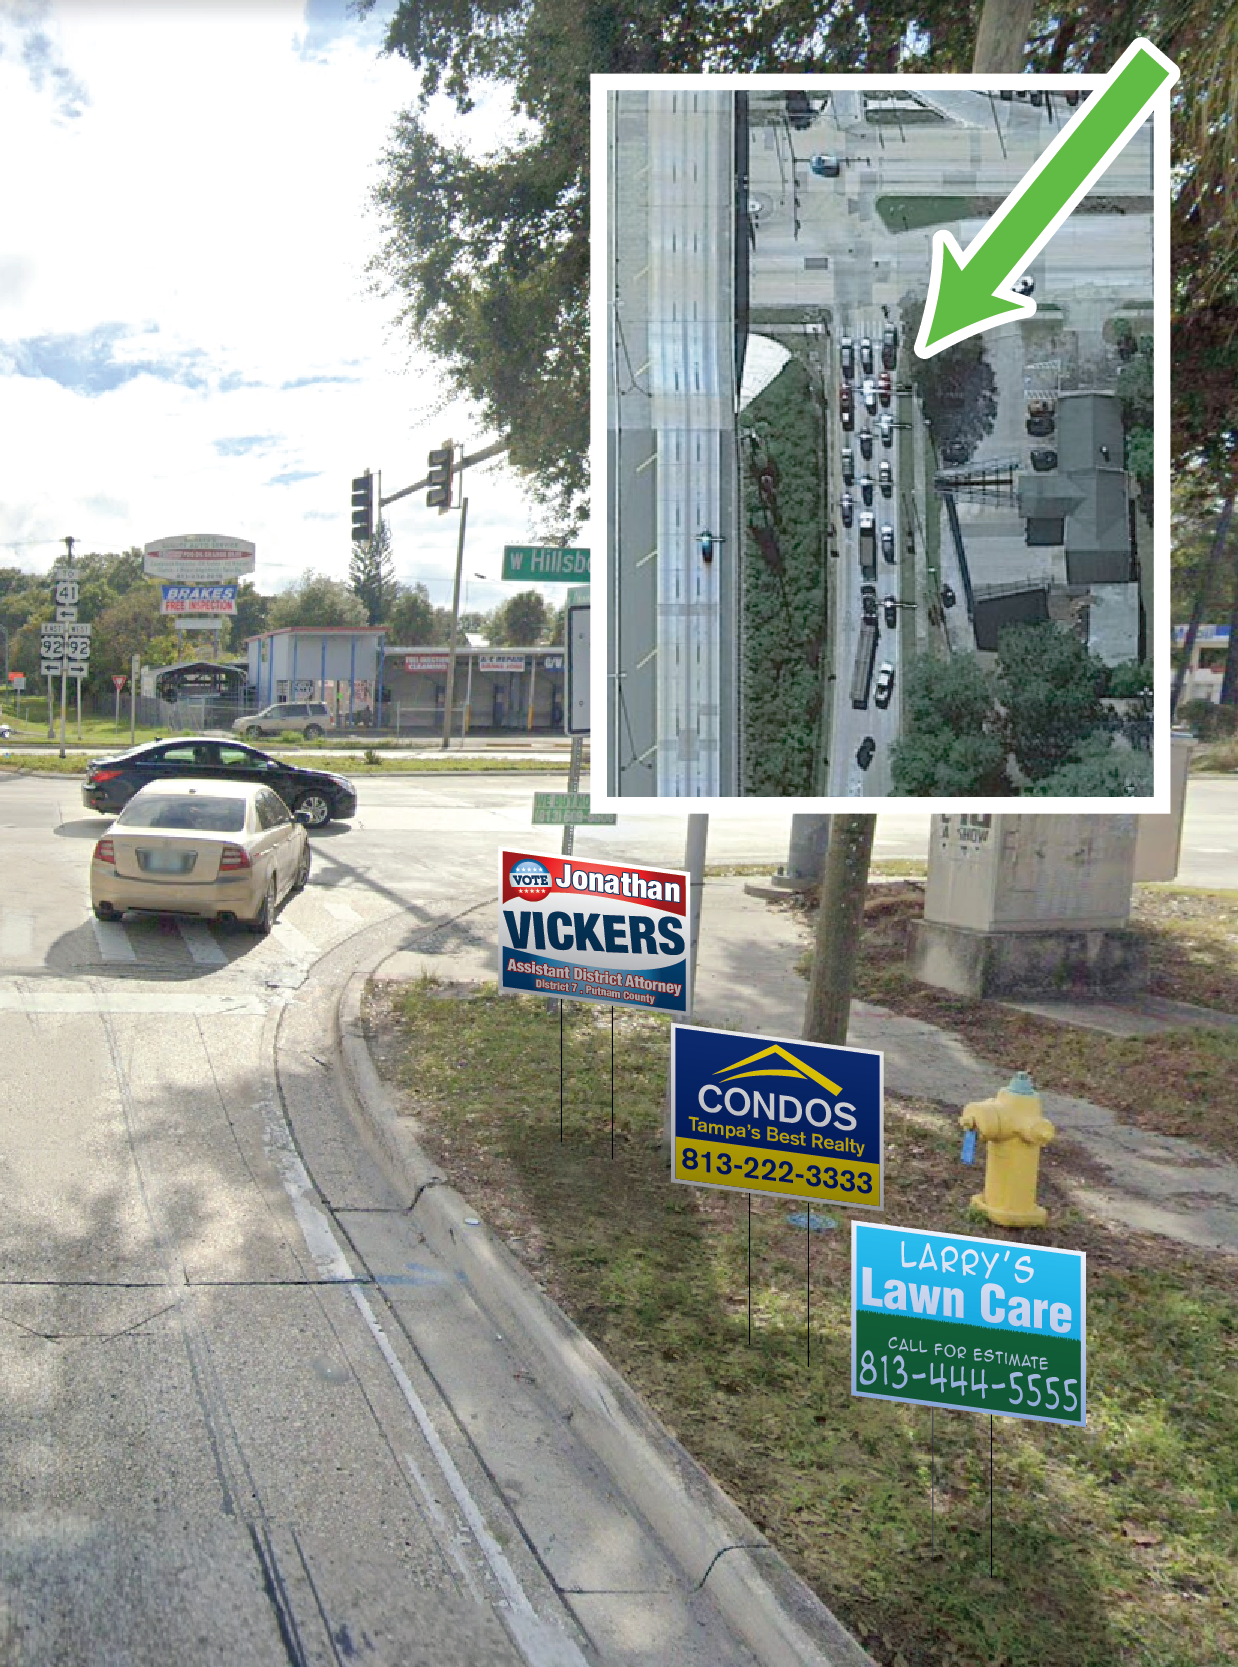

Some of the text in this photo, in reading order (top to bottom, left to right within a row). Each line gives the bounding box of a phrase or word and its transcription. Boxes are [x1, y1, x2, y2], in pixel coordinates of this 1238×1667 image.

[62, 569, 74, 578] TO
[510, 549, 590, 573] W Hillsb
[59, 587, 75, 600] 41
[165, 602, 233, 611] FREE INSPECTION
[167, 587, 234, 600] BRAKES
[71, 625, 88, 633] WEST
[43, 641, 61, 654] 92
[70, 641, 88, 655] 92
[535, 794, 550, 807] WE
[555, 794, 577, 807] BUY
[513, 863, 681, 903] VOTE Jonathan
[503, 910, 685, 955] VICKERS
[507, 958, 682, 996] Assistant District Attorney
[535, 979, 570, 992] District
[571, 983, 578, 992] 7
[585, 985, 621, 999] Putnam
[623, 991, 656, 1005] County
[698, 1084, 858, 1131] CONDOS
[688, 1116, 865, 1157] Tampa's Best Realty
[682, 1147, 873, 1194] 813-222-3333
[901, 1241, 1035, 1284] LARRY'S
[862, 1266, 1072, 1333] Lawn Care
[888, 1337, 1049, 1371] CALL FOR ESTIMATE
[859, 1350, 1078, 1412] 813-444-5555
